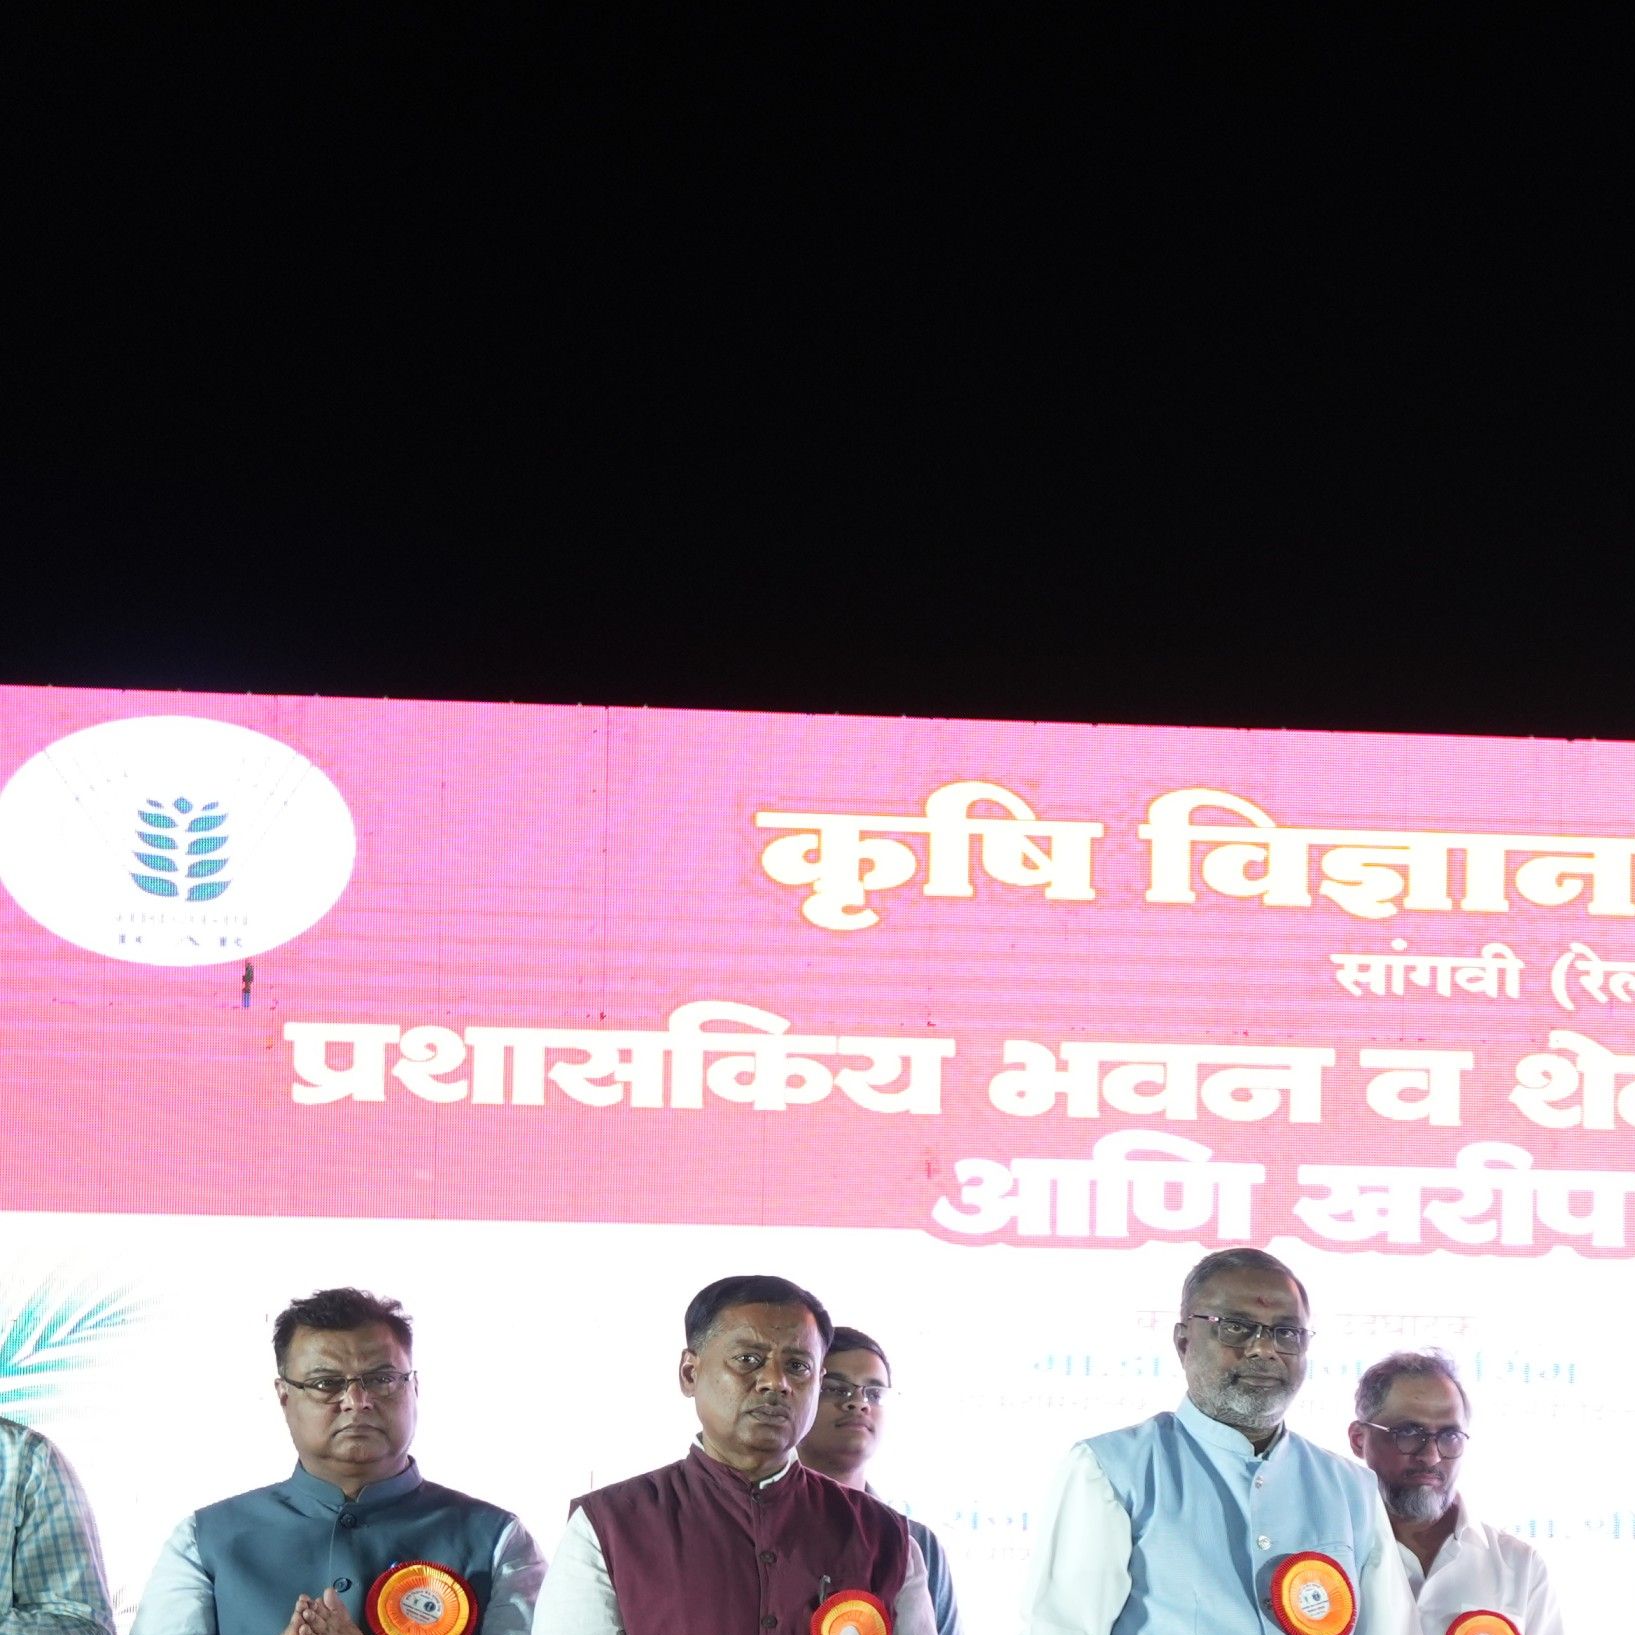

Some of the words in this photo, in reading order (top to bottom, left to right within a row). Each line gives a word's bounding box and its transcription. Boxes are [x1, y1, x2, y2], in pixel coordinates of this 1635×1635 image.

[755, 780, 1104, 931] कृषि
[1330, 936, 1525, 999] सांगवी
[283, 1000, 957, 1117] प्रशासकिय
[988, 1037, 1337, 1124] भवन
[1358, 1047, 1475, 1128] व
[931, 1128, 1267, 1241] आणि
